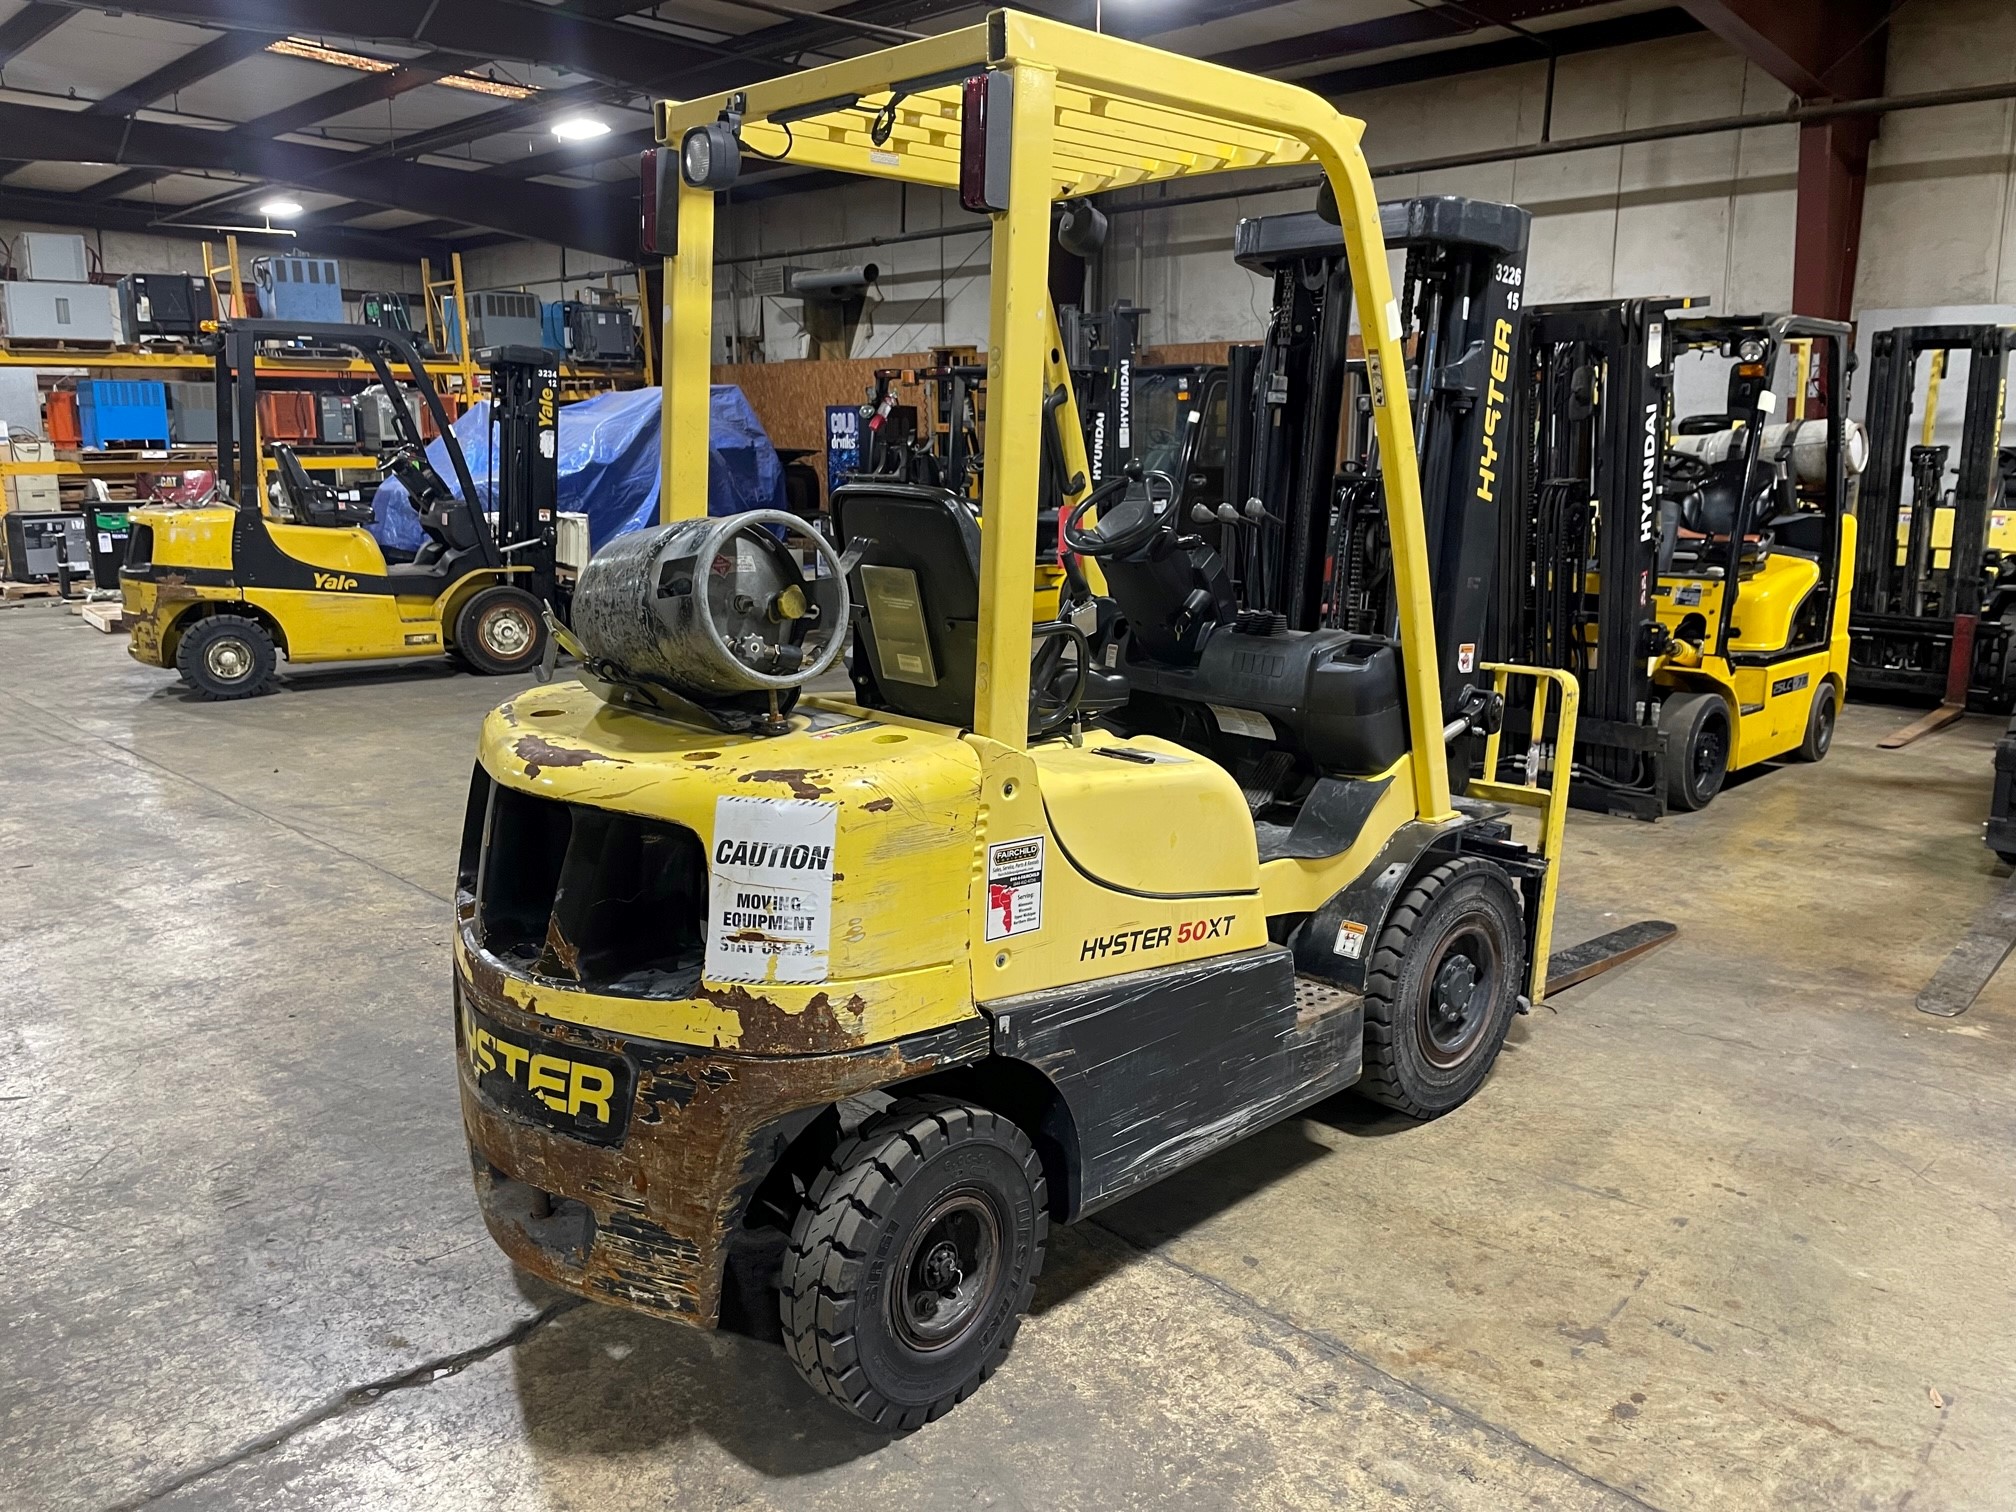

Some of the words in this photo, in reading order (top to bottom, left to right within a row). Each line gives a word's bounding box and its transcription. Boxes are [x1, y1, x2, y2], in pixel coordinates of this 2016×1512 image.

[1495, 263, 1522, 286] 3226
[1506, 291, 1520, 311] 15
[538, 369, 558, 379] 3234
[548, 379, 558, 388] 12
[538, 387, 554, 427] Yale
[1120, 359, 1130, 428] HYUNDAI
[1476, 318, 1513, 503] HYSTER
[1092, 411, 1106, 481] HYUNDAI
[1640, 403, 1657, 543] HYUNDAI
[313, 572, 358, 591] Yale
[715, 839, 831, 871] CAUTION
[996, 846, 1038, 860] FAIRCHILD
[736, 893, 801, 912] MOVING
[723, 912, 815, 931] EQUIPMENT
[1080, 926, 1172, 961] HYSTER
[1177, 915, 1236, 944] 50XT
[461, 1003, 615, 1124] YSTER
